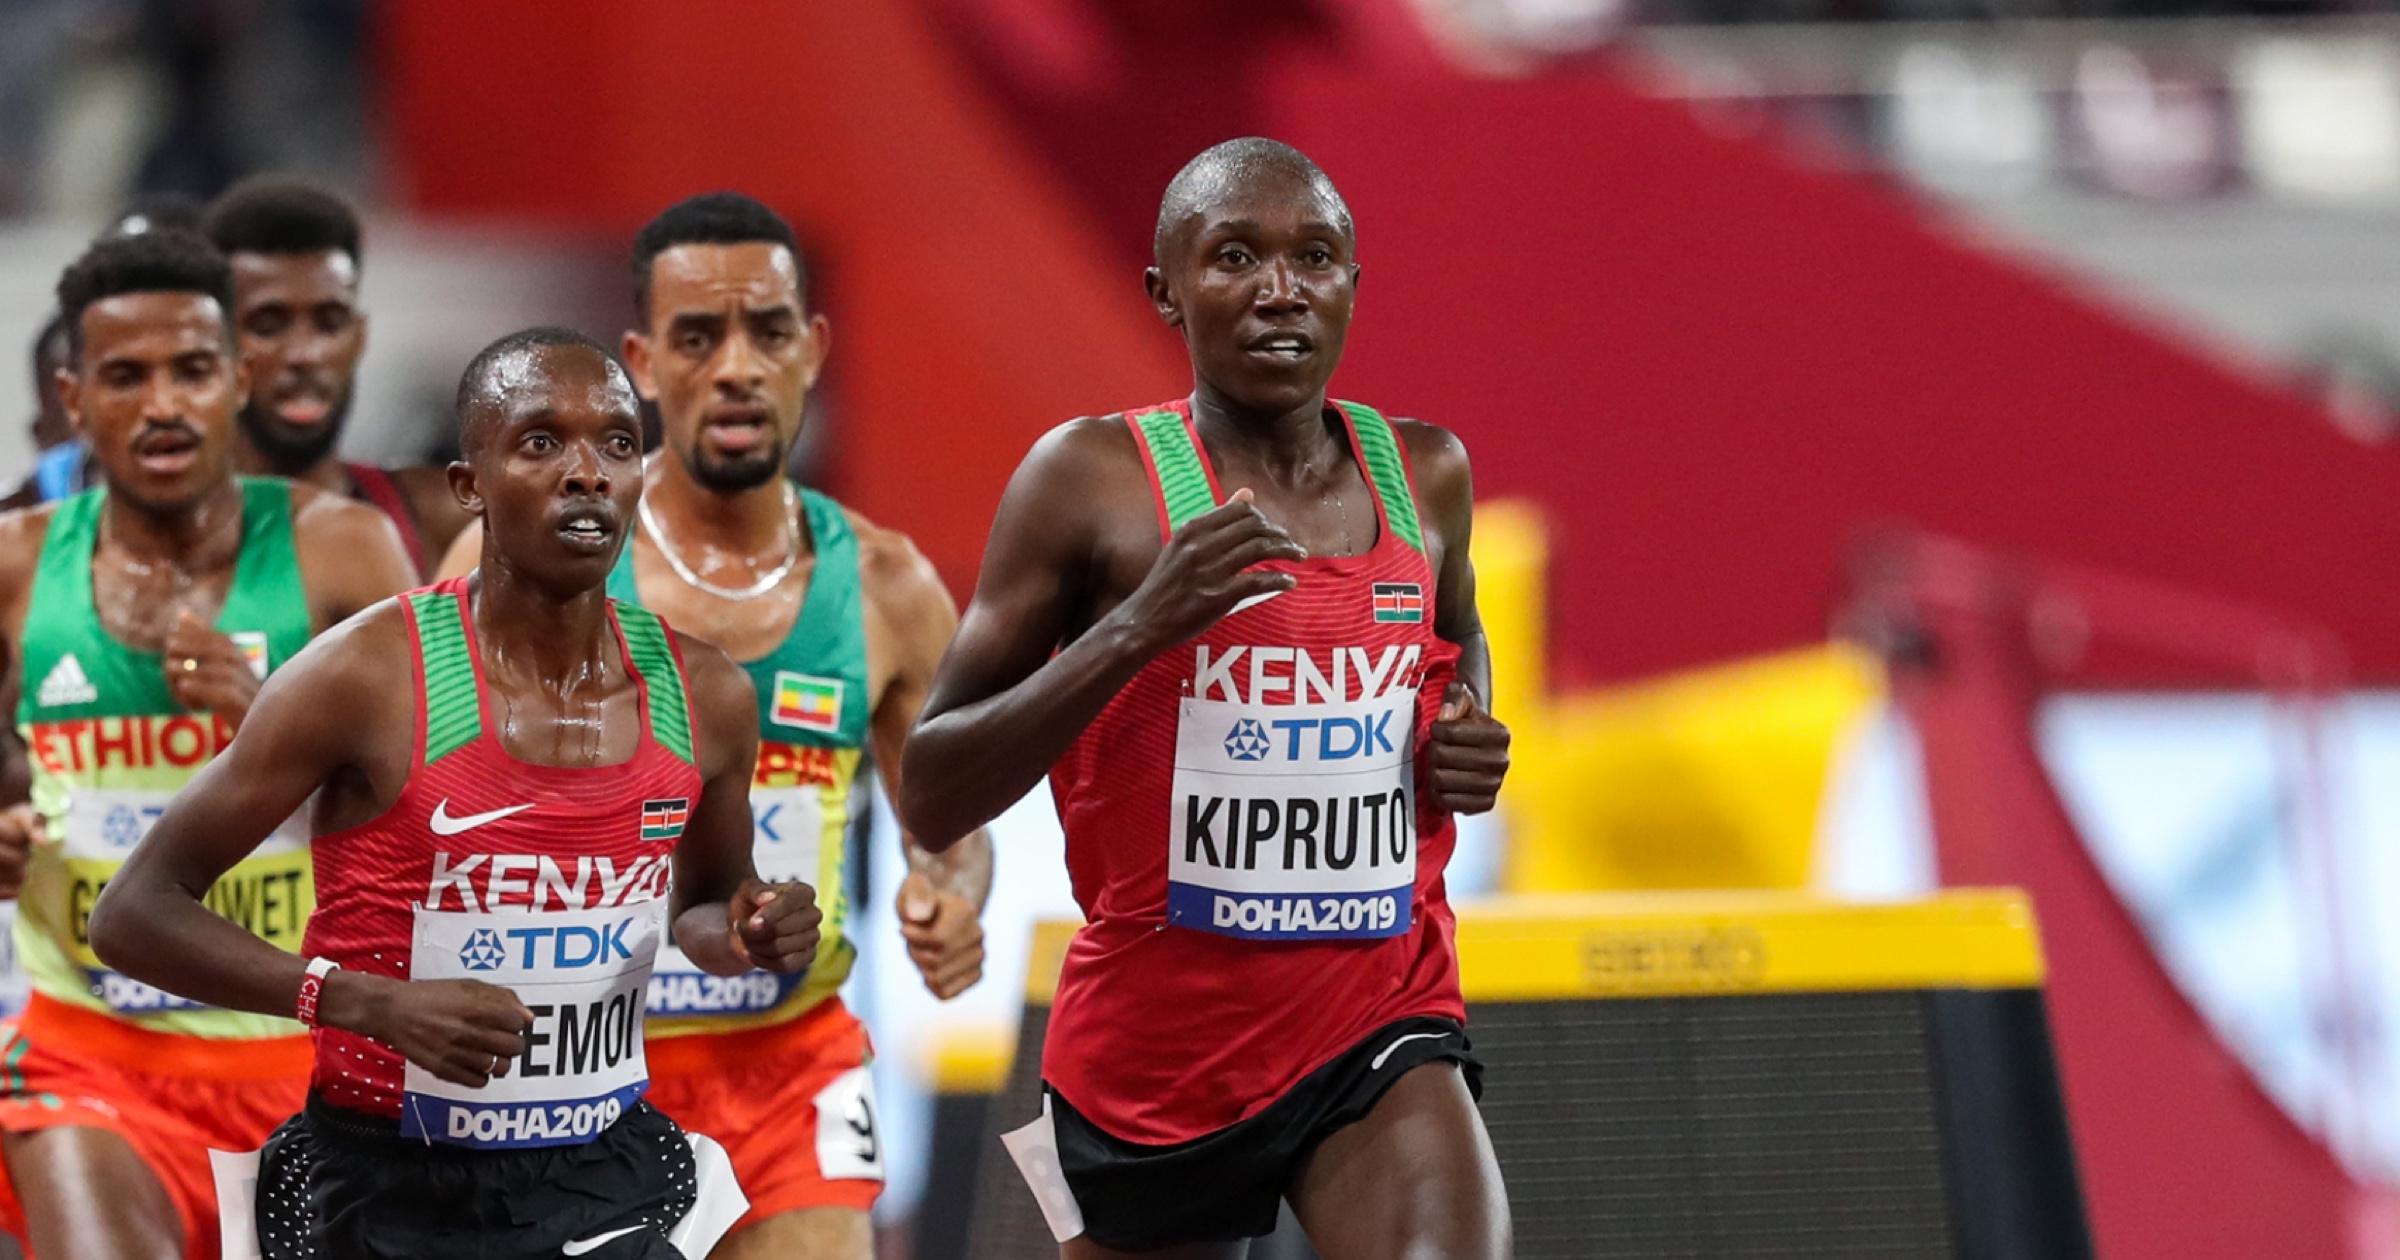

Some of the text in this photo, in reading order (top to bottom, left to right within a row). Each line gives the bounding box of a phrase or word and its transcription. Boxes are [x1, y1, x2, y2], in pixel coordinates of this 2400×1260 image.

[1271, 709, 1394, 761] TDK
[1184, 787, 1408, 871] KIPRUTO
[1212, 895, 1397, 932] DOHA2019
[506, 917, 634, 969] TDK
[645, 974, 779, 1011] HA2019
[493, 987, 638, 1079] EMOI
[447, 1097, 622, 1142] DOHA2019
